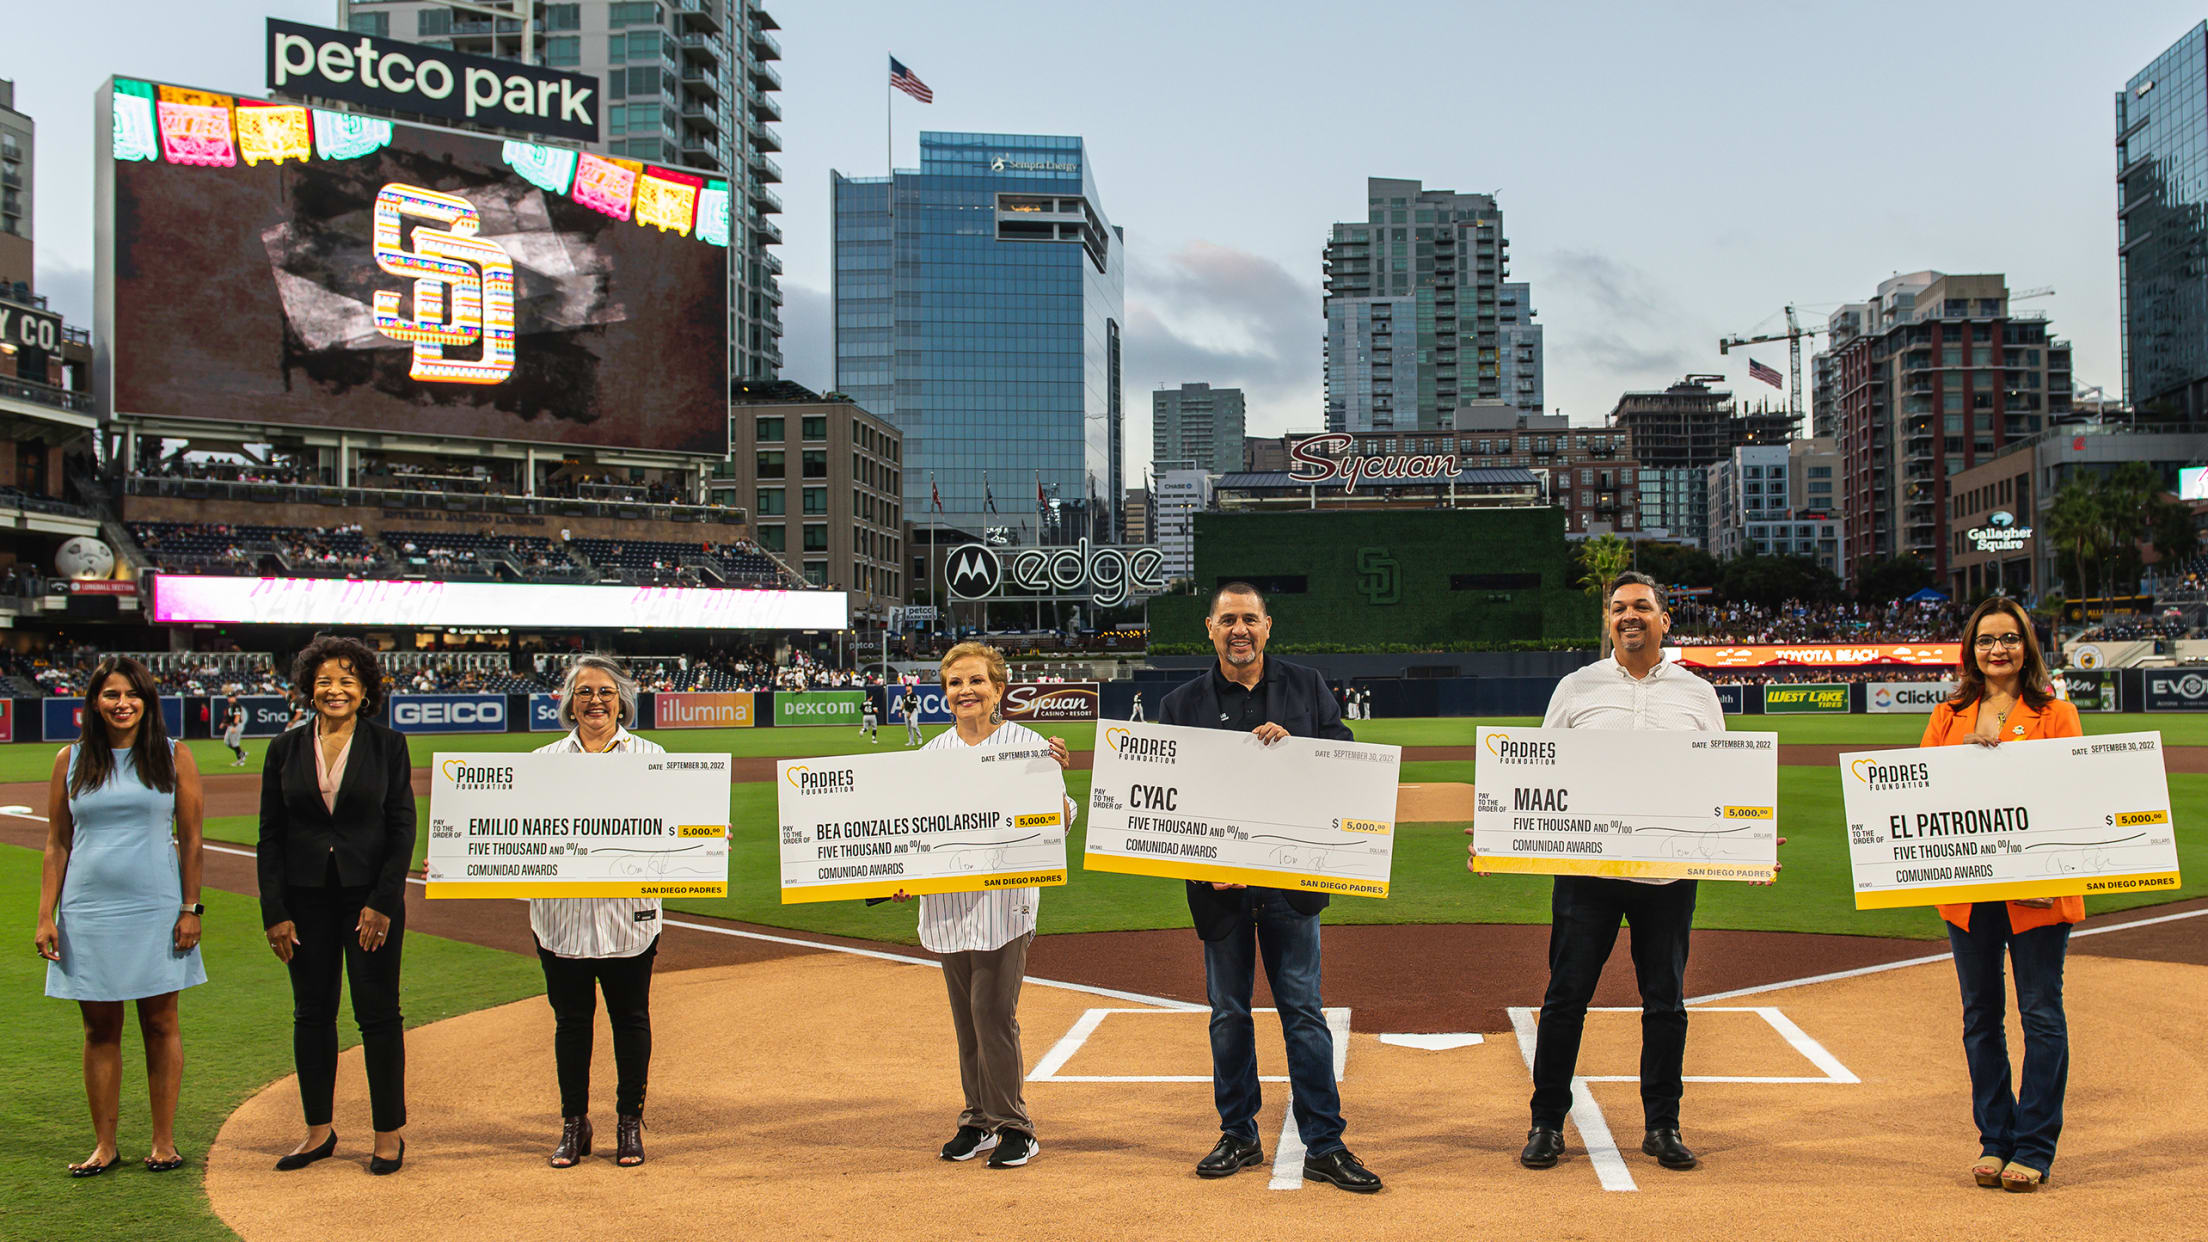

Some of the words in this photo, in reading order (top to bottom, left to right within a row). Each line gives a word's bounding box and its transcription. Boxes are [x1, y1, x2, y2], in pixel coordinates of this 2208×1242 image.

[274, 32, 455, 100] petco
[465, 66, 594, 126] park
[1009, 160, 1045, 172] Sempra
[1046, 160, 1078, 173] Energy
[20, 314, 60, 353] CO.
[1288, 433, 1463, 495] Sycuan
[1967, 527, 2033, 541] Gallagher
[1976, 540, 2024, 552] Square
[1013, 537, 1165, 607] edge
[849, 641, 874, 650] petco
[1776, 649, 1834, 662] TOYOTA
[1836, 649, 1879, 662] BEACH
[1006, 686, 1088, 718] Sycuan
[1768, 690, 1808, 703] WEST
[1809, 690, 1845, 702] LAKE
[1896, 690, 1948, 704] ClickU
[394, 702, 504, 725] GEICO
[662, 699, 748, 723] illumina
[1120, 735, 1177, 757] PADRES
[1500, 741, 1556, 759] PADRES
[1692, 741, 1707, 749] DATE
[1710, 740, 1744, 748] SEPTEMBER
[2072, 748, 2088, 756] DATE
[2091, 741, 2127, 753] SEPTEMBER
[2139, 741, 2155, 750] 2022
[998, 749, 1029, 760] SEPTEMBER
[1119, 753, 1176, 764] FOUNDATION
[1315, 750, 1330, 758] DATE
[1500, 757, 1556, 765] FOUNDATION
[666, 761, 699, 769] SEPTEMBER
[710, 761, 724, 769] 2022
[457, 766, 513, 783] PADRES
[801, 769, 854, 788] PADRES
[1868, 763, 1928, 784] PADRES
[801, 786, 854, 795] FOUNDATION
[1869, 781, 1930, 791] FOUNDATION
[1130, 784, 1178, 812] CYAC
[1514, 788, 1568, 812] MAAC
[1714, 806, 1721, 817] $
[469, 818, 518, 836] EMILIO
[522, 818, 568, 836] NARES
[573, 818, 662, 836] FOUNDATION
[817, 823, 841, 840] BEA
[844, 818, 909, 838] GONZALES
[912, 812, 1000, 834] SCHOLARSHIP
[1006, 817, 1012, 827] $
[1128, 816, 1150, 830] FIVE
[1152, 818, 1208, 836] THOUSAND
[1209, 827, 1225, 838] AND
[1332, 818, 1339, 829] $
[1513, 818, 1534, 830] FIVE
[1537, 818, 1591, 832] THOUSAND
[1593, 824, 1609, 833] AND
[1890, 814, 1913, 839] EL
[1917, 806, 2029, 838] PATRONATO
[2106, 815, 2113, 826] $
[668, 827, 675, 836] $
[1512, 839, 1564, 852] COMUNIDAD
[1566, 841, 1603, 853] AWARDS
[1853, 837, 1875, 845] ORDER
[468, 843, 490, 855] FIVE
[493, 843, 546, 855] THOUSAND
[549, 846, 564, 855] AND
[818, 845, 838, 859] FIVE
[840, 842, 891, 857] THOUSAND
[894, 844, 908, 853] AND
[1126, 838, 1179, 855] COMUNIDAD
[1180, 843, 1217, 859] AWARDS
[1894, 846, 1917, 860] FIVE
[1919, 841, 1977, 858] THOUSAND
[1981, 844, 1996, 854] AND
[467, 864, 519, 876] COMUNIDAD
[521, 864, 558, 876] AWARDS
[818, 865, 868, 880] COMUNIDAD
[869, 862, 904, 876] AWARDS
[1896, 867, 1952, 882] COMUNIDAD
[1954, 864, 1993, 879] AWARDS
[1003, 877, 1028, 885] DIEGO
[1030, 875, 1062, 883] PADRES
[1300, 879, 1318, 887] SAN
[1320, 881, 1347, 890] DIEGO
[1349, 884, 1383, 894] PADRES
[2086, 882, 2105, 890] SAN
[2108, 880, 2136, 889] DIEGO
[2139, 877, 2175, 887] PADRES
